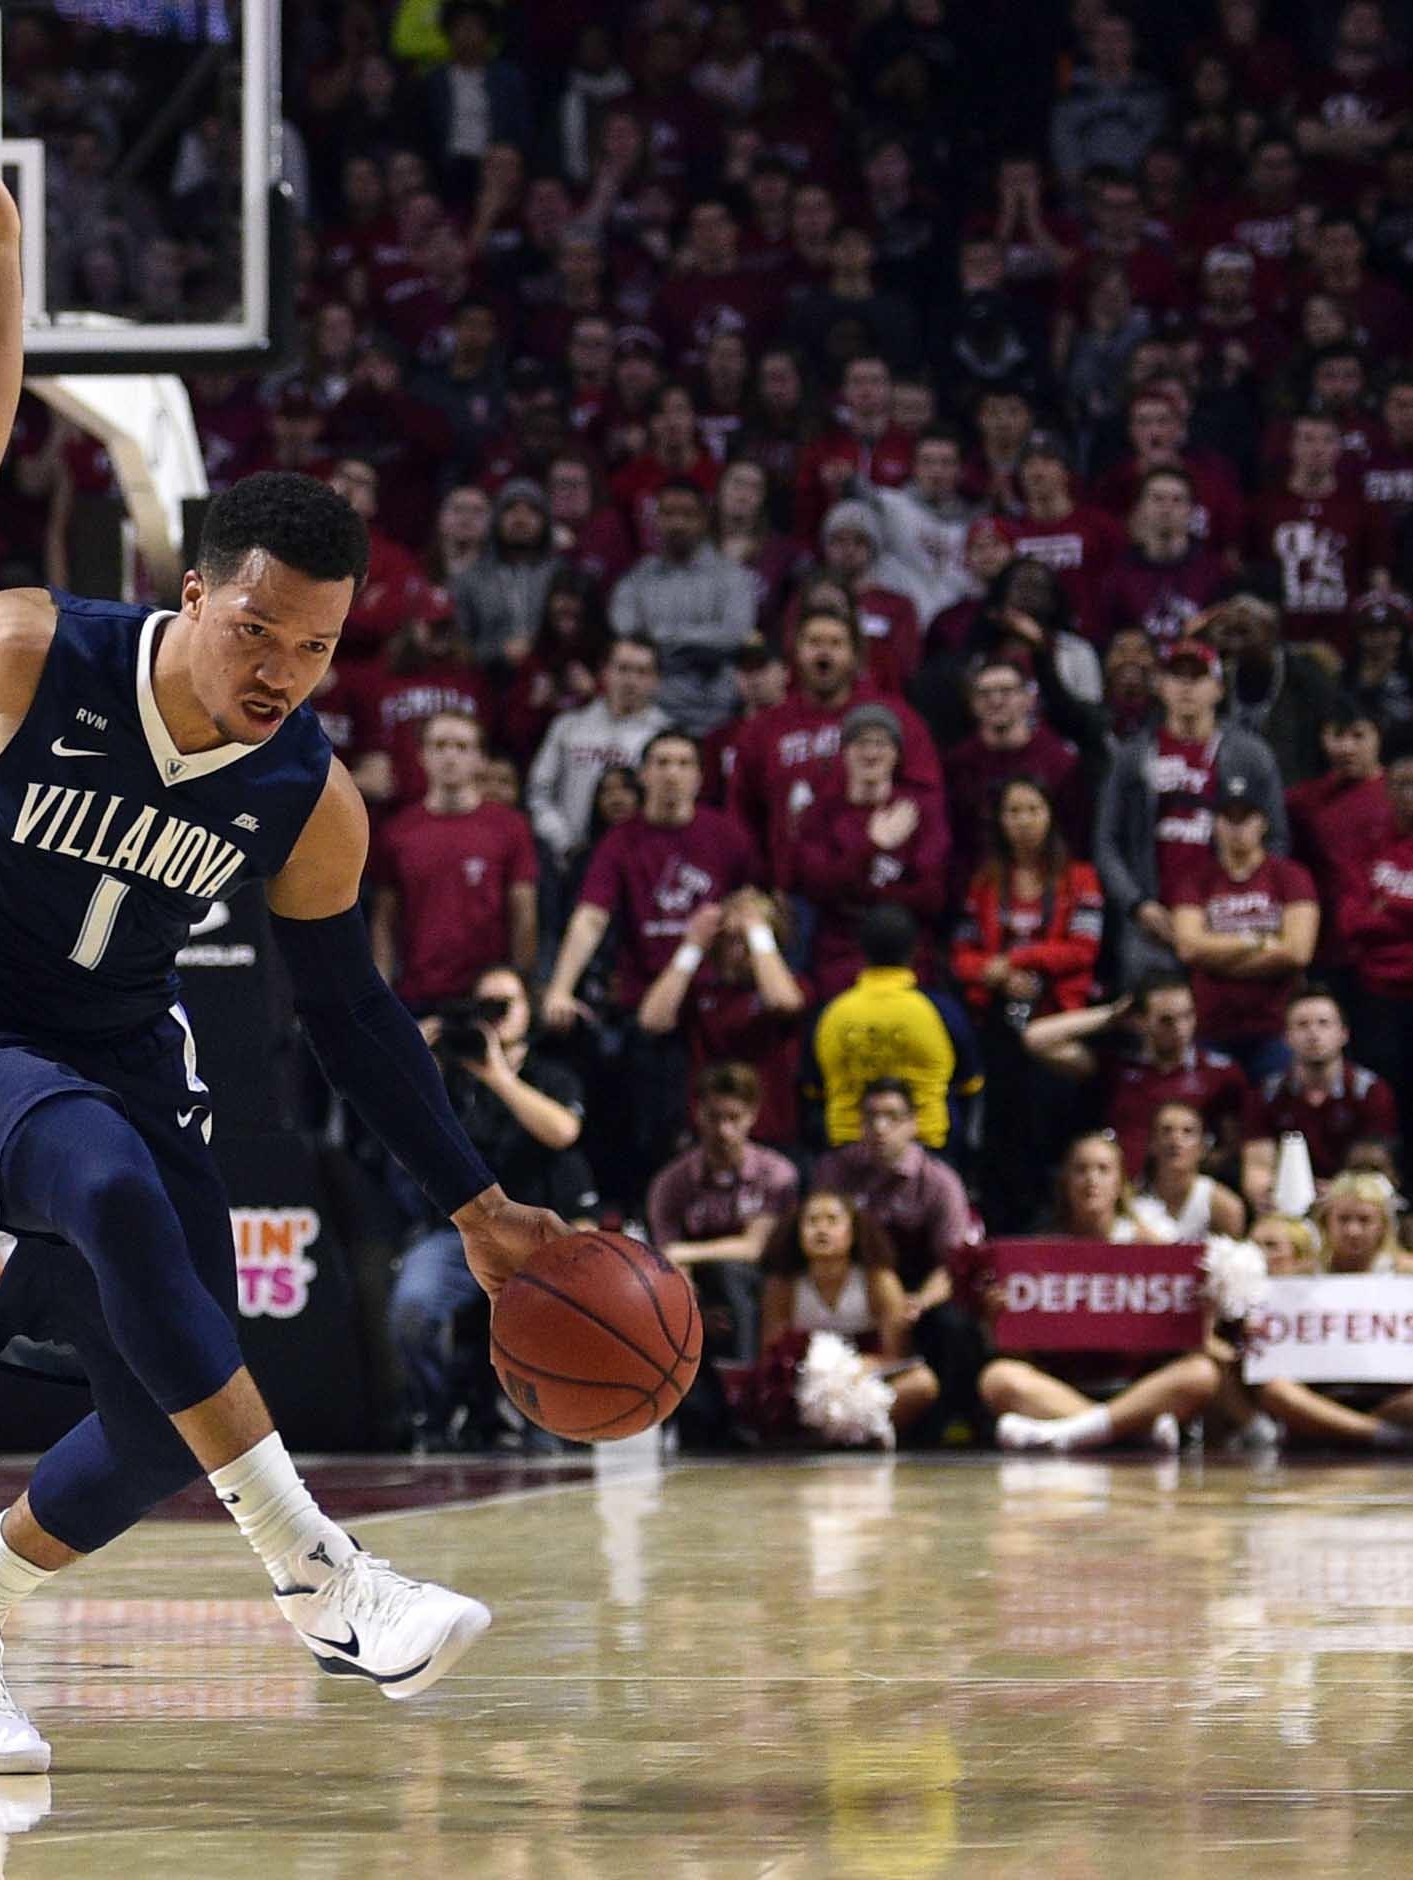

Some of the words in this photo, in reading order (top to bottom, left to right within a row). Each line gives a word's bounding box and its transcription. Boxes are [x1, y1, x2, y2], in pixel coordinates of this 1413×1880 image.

[75, 707, 109, 732] RVM
[11, 782, 247, 898] VILLANOVA
[67, 873, 132, 971] 1
[1006, 1272, 1196, 1313] DEFENSE
